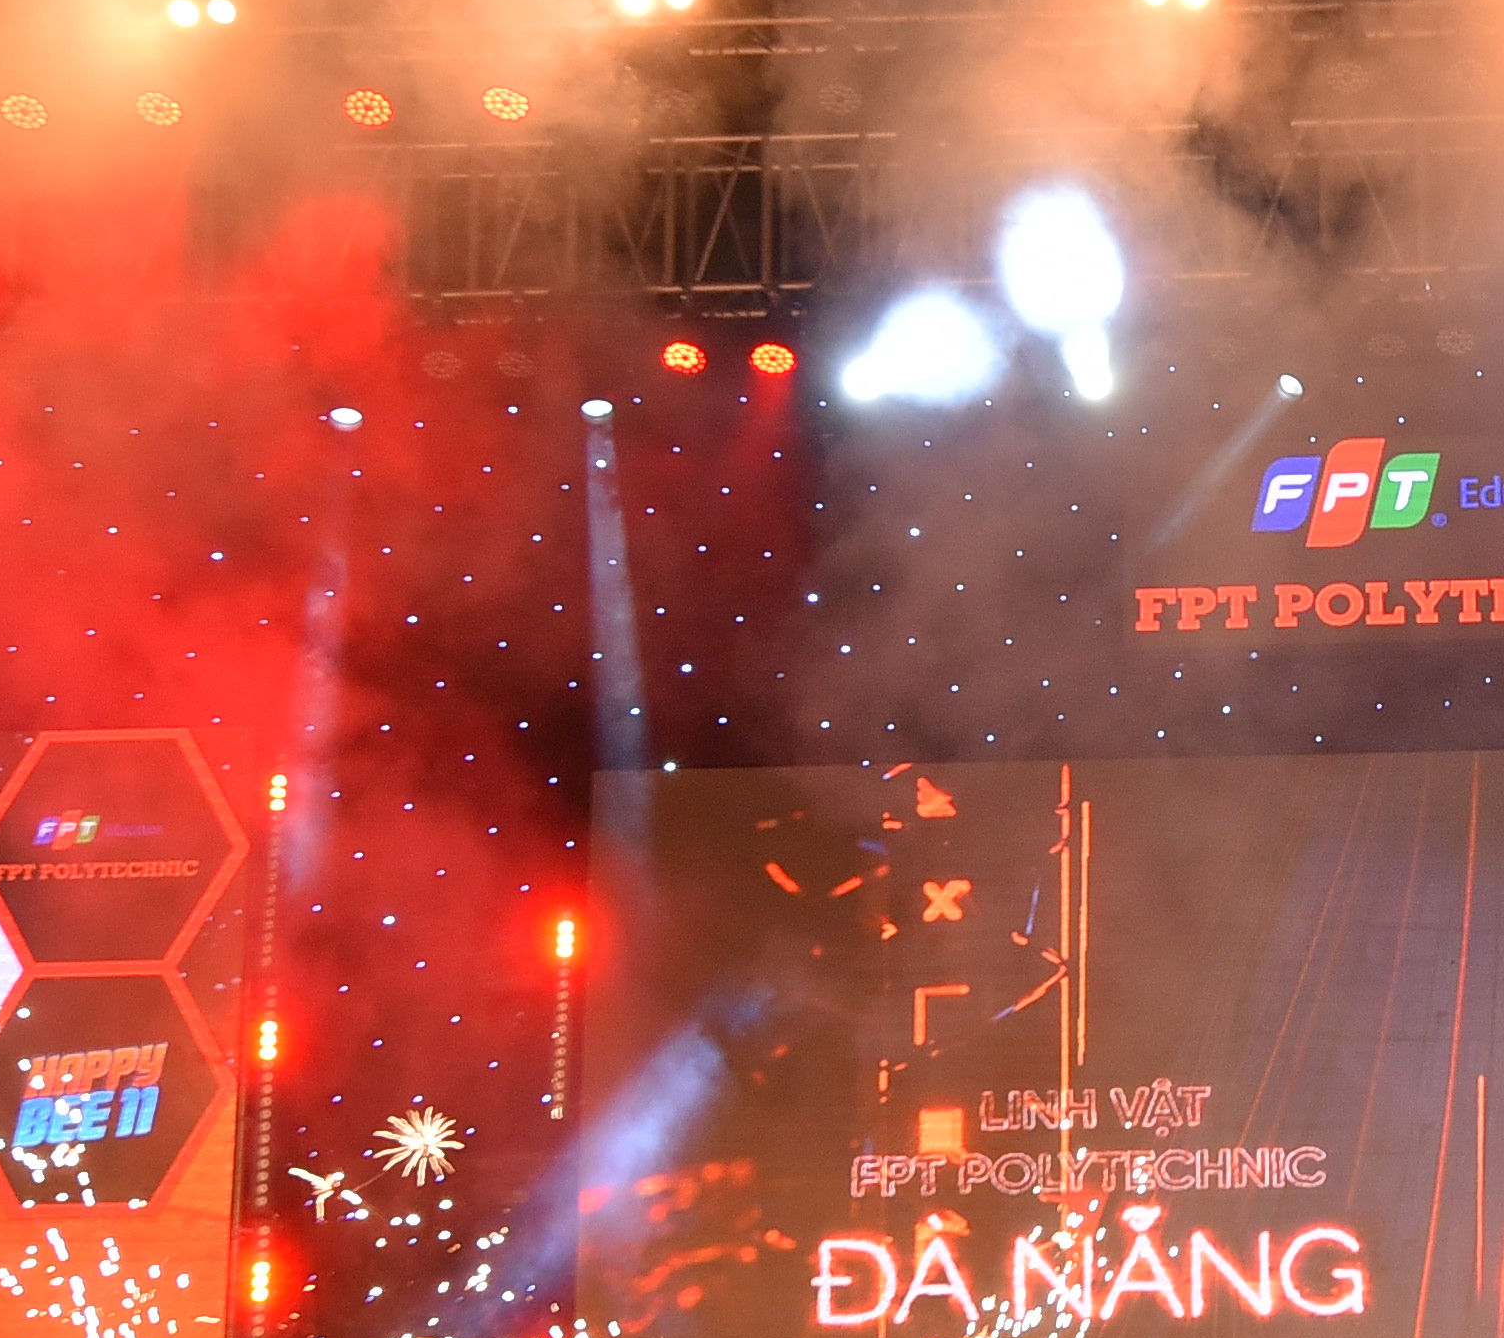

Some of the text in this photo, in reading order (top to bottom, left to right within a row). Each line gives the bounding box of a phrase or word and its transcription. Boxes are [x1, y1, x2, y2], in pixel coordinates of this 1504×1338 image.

[1134, 584, 1258, 632] FPT
[39, 860, 200, 880] POLYTECHNIC
[23, 1041, 169, 1099] HAPPY
[12, 1089, 116, 1148] BEE
[979, 1077, 1212, 1138] LINH VẬT
[849, 1146, 1327, 1198] FPT POLYTECHNIC
[810, 1213, 980, 1326] ĐÀ
